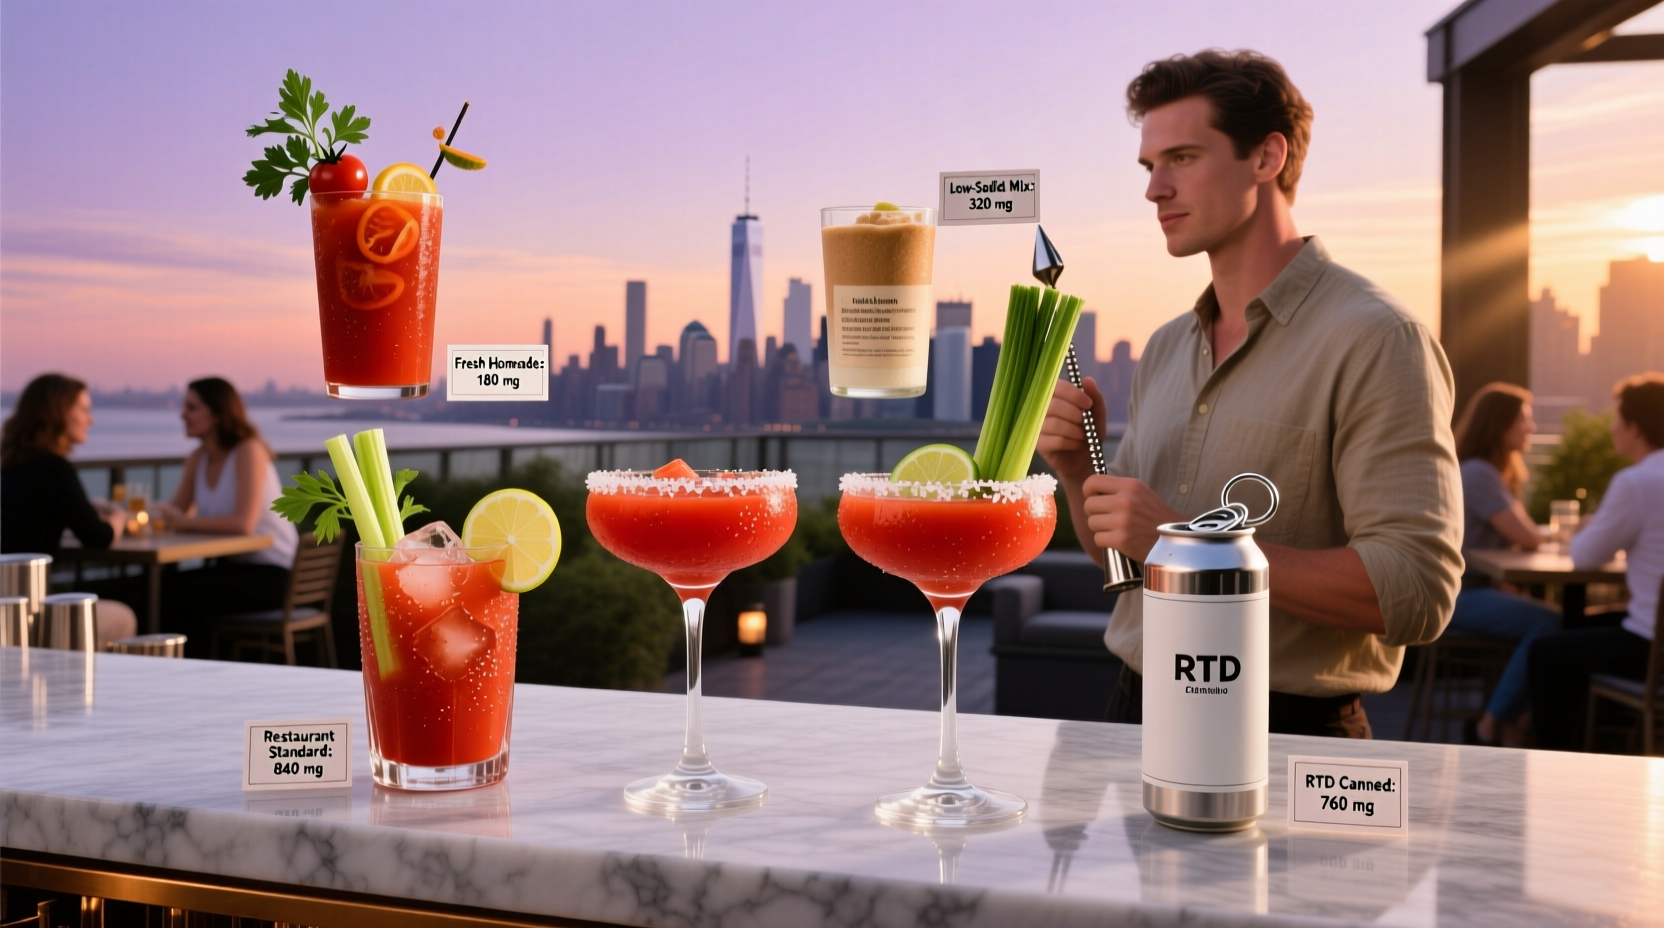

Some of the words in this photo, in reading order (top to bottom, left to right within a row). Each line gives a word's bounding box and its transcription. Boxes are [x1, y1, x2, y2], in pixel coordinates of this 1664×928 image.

[969, 197, 991, 210] 320
[995, 200, 1013, 213] mg
[455, 356, 486, 369] Fresh
[477, 373, 499, 386] 180
[503, 377, 520, 389] mg
[1175, 653, 1241, 682] RTD
[264, 730, 335, 743] Restaurant
[274, 762, 300, 775] 840
[304, 765, 323, 778] mg
[1306, 774, 1335, 789] RTD
[1339, 775, 1396, 793] Canned:
[1321, 795, 1348, 811] 760
[1353, 800, 1375, 817] mg
